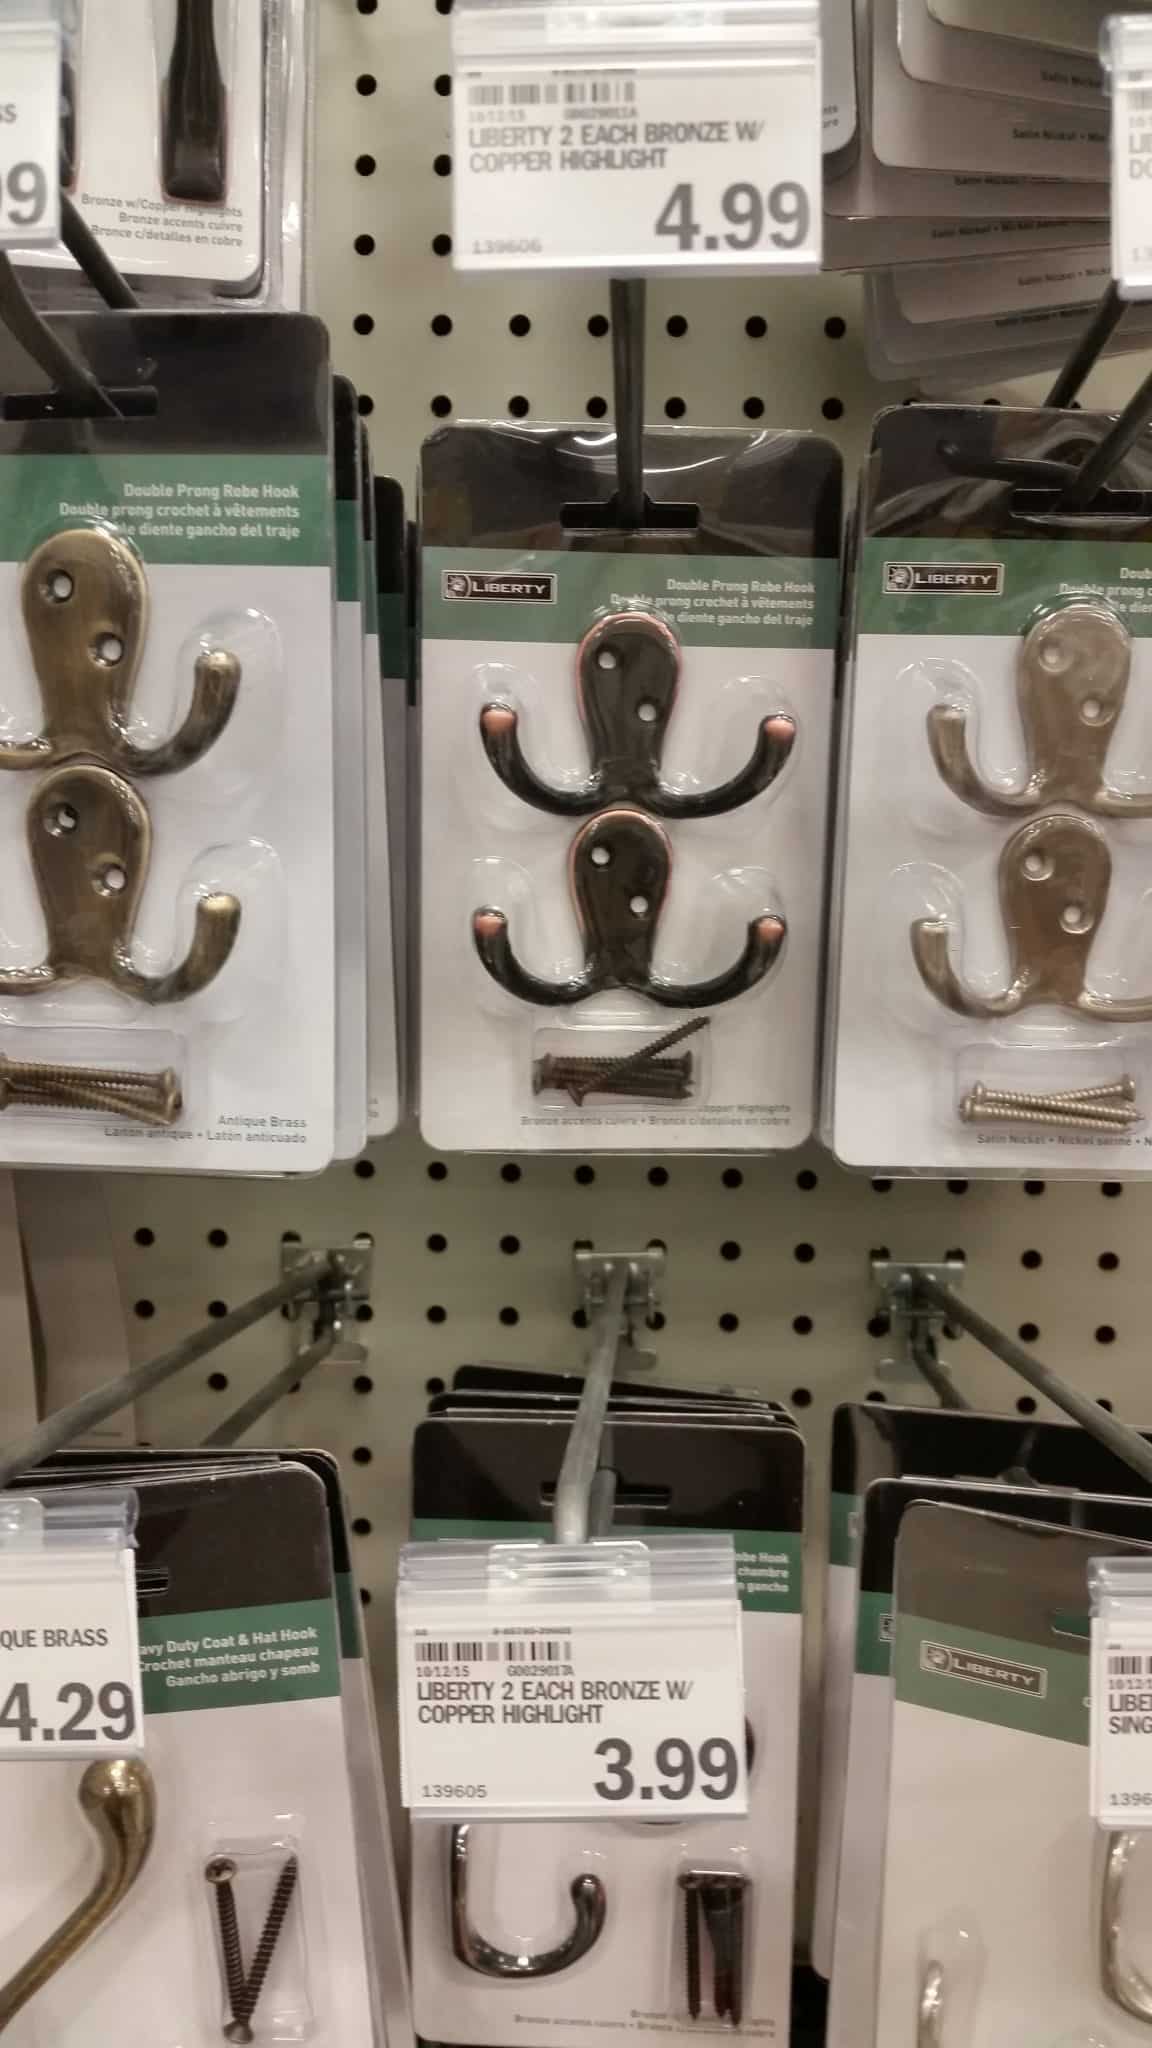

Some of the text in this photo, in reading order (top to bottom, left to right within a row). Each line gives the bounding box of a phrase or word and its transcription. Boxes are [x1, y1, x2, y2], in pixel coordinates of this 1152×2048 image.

[469, 120, 766, 147] LIBERTY 2 EACH BRONZE W/
[470, 148, 668, 173] COPPER HIGHLIGHT
[0, 162, 47, 226] 9
[81, 193, 123, 208] Bronze
[119, 212, 243, 233] Bronze accents cuivre
[655, 181, 811, 251] 4.99
[91, 225, 132, 239] Bronce
[195, 235, 210, 244] en
[211, 234, 243, 247] cobre
[124, 483, 300, 500] Double Prong Robe Hook
[59, 501, 300, 519] Double prong crochet à vêtements
[139, 524, 184, 537] diente
[186, 523, 237, 539] gancho
[240, 523, 263, 537] del
[265, 524, 300, 540] traje
[472, 580, 547, 595] LIBERTY
[667, 578, 815, 594] Double Prong Robe Hook
[915, 573, 993, 586] LIBERTY
[1106, 586, 1145, 599] prong
[655, 596, 692, 610] prong
[693, 594, 739, 608] crochet
[741, 595, 749, 607] à
[751, 596, 815, 609] vêtements
[677, 612, 716, 624] diente
[717, 613, 761, 627] gancho
[763, 613, 782, 625] del
[784, 613, 813, 628] traje
[218, 1114, 307, 1129] Antique Brass
[245, 1130, 307, 1143] anticuado
[977, 1133, 1007, 1145] Satin
[758, 1552, 790, 1564] Hook
[738, 1566, 790, 1579] chambre
[746, 1582, 790, 1594] gancho
[0, 1628, 109, 1651] QUE BRASS
[166, 1639, 200, 1653] Duty
[202, 1635, 235, 1649] Coat
[238, 1633, 249, 1646] &
[252, 1631, 278, 1645] Hat
[280, 1626, 318, 1642] Hook
[194, 1652, 257, 1668] manteau
[259, 1645, 320, 1661] chapeau
[165, 1661, 321, 1688] Gancho abrigo y somb
[416, 1665, 471, 1678] 10/12/15
[953, 1658, 1035, 1686] LIBERTY
[416, 1680, 694, 1701] LIBERTY 2 EACH BRONZE W/
[0, 1681, 136, 1741] 4.29
[418, 1704, 605, 1724] COPPER HIGHLIGHT
[593, 1737, 739, 1801] 3.99
[421, 1784, 488, 1799] 139605
